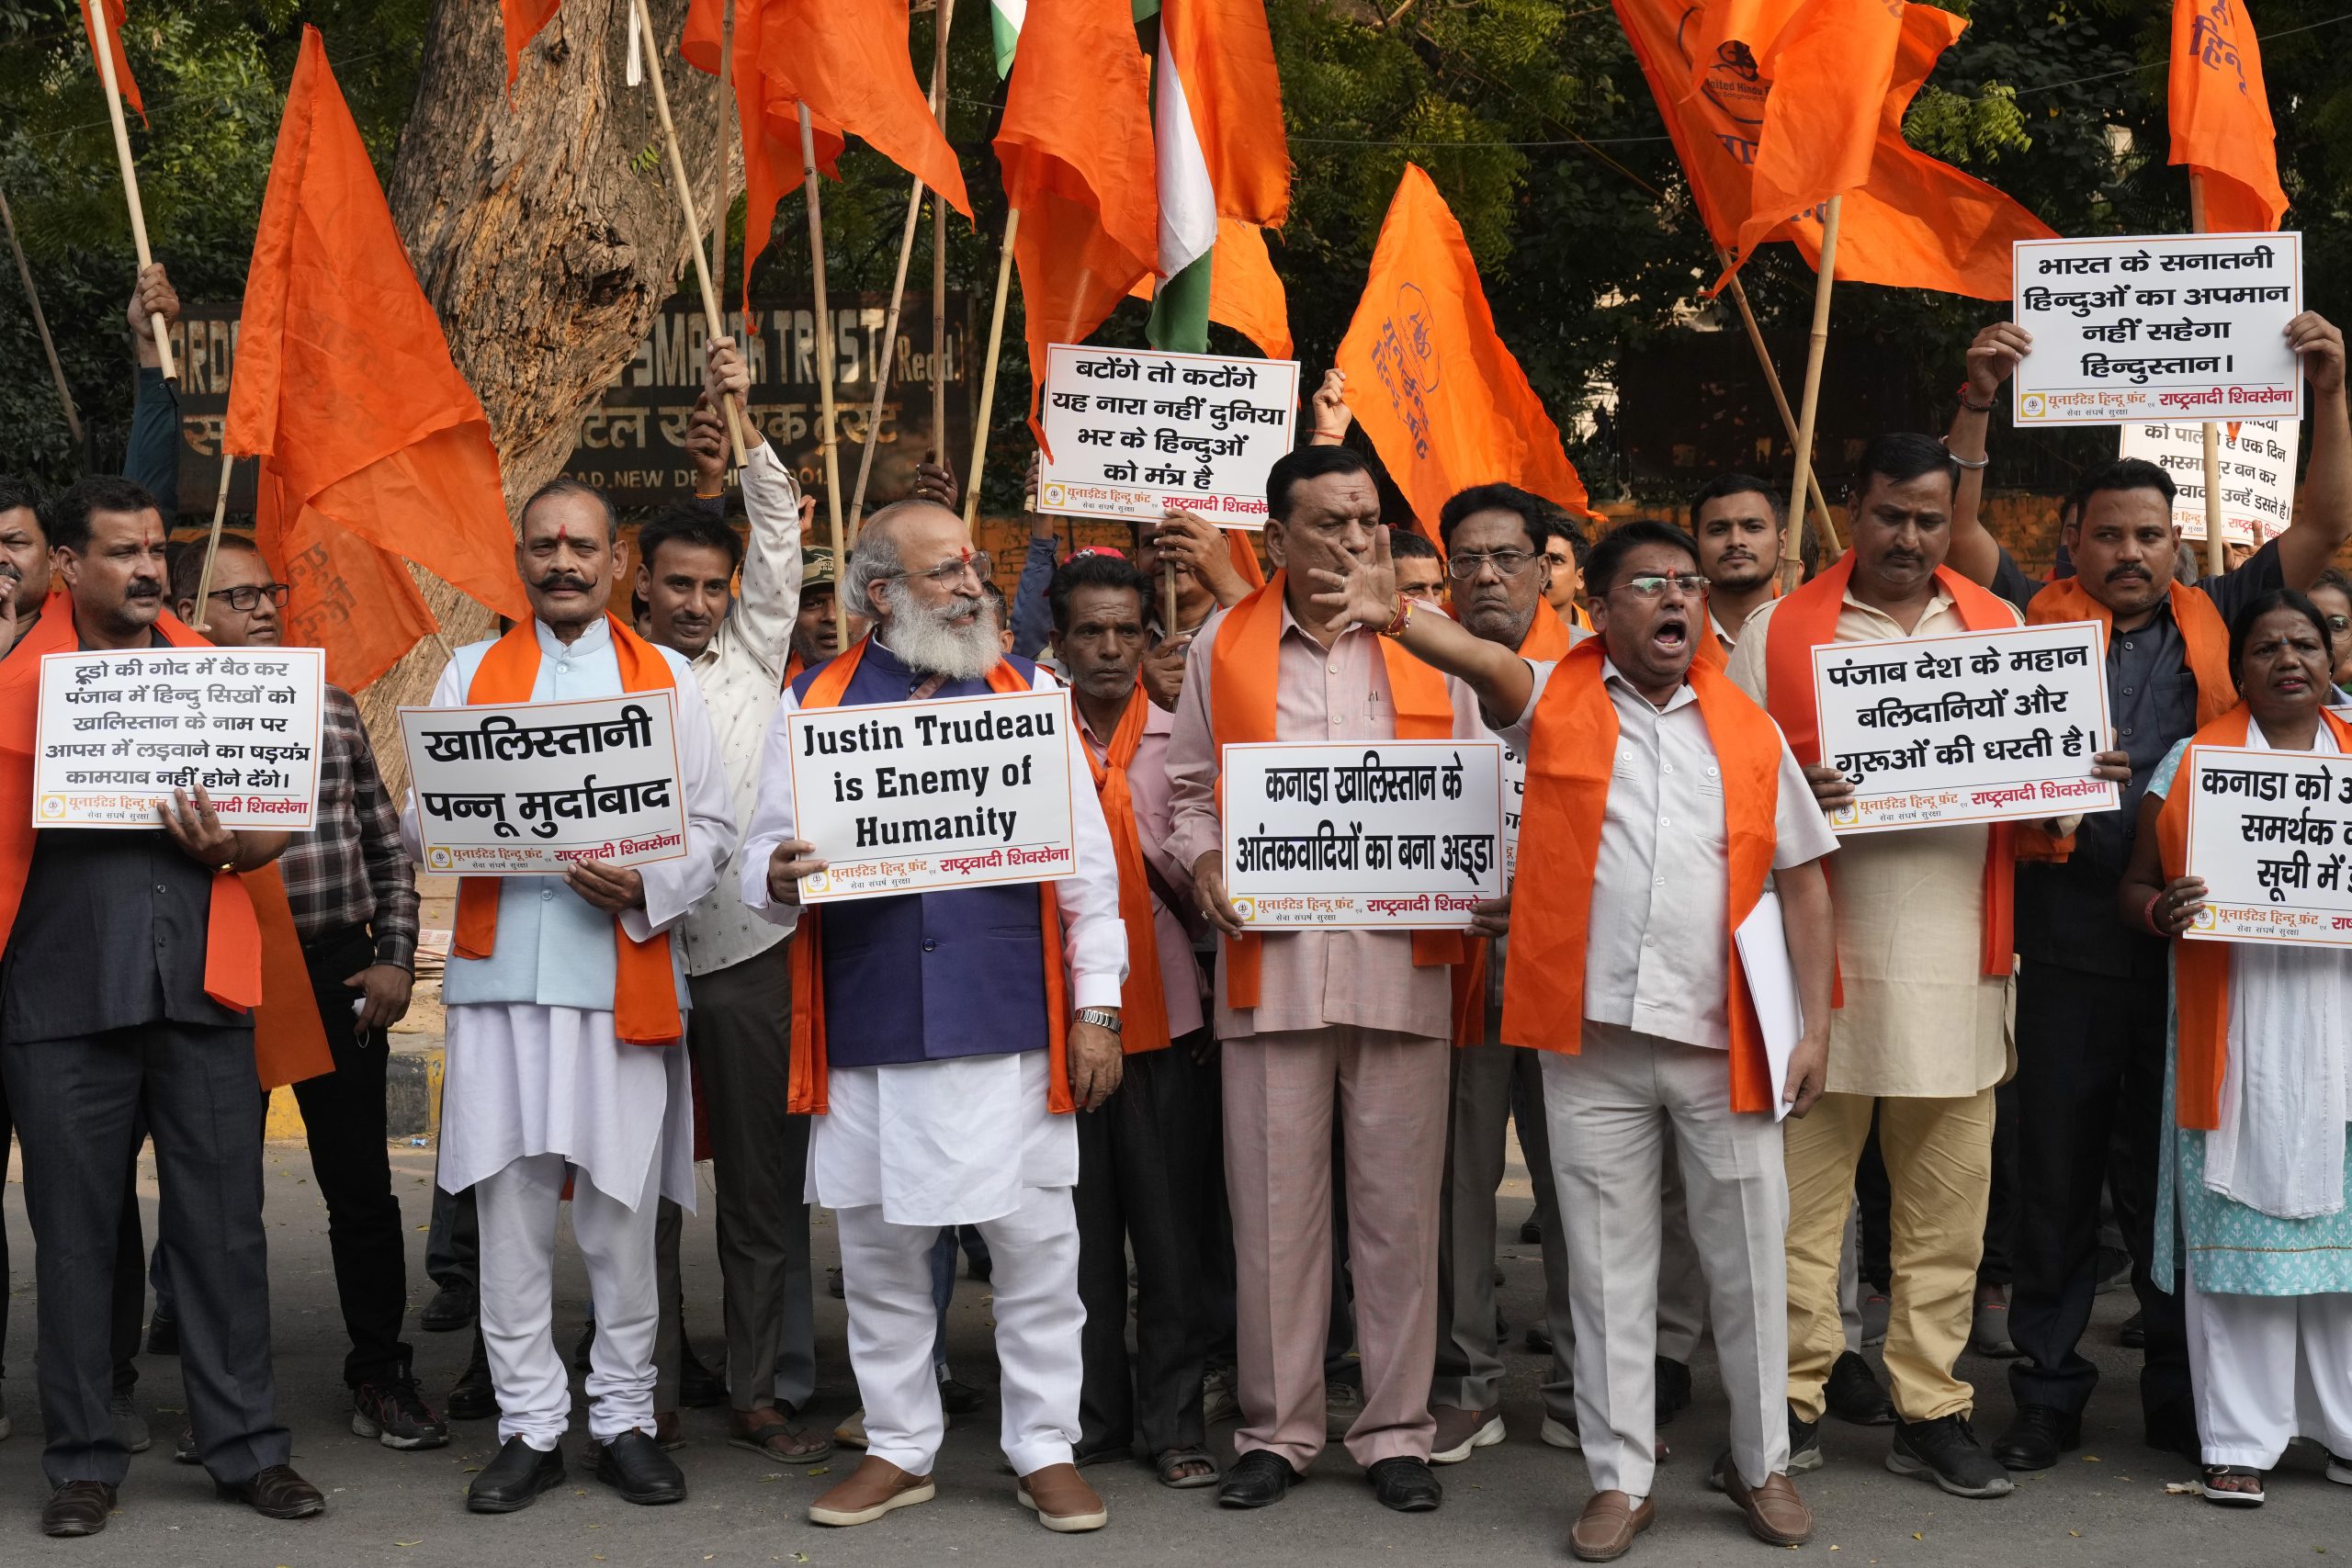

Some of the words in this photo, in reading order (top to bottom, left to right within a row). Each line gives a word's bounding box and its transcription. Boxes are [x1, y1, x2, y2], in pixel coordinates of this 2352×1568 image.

[2039, 256, 2111, 274] भारत
[2120, 249, 2151, 273] के
[2160, 245, 2274, 272] सनातनी
[2024, 285, 2131, 317] हिन्दुओं
[2135, 289, 2177, 306] का
[2184, 286, 2290, 305] अपमान
[2083, 317, 2143, 343] नहीं
[2146, 317, 2232, 341] सहेगा
[1076, 356, 1140, 381] बटोंगे
[1148, 361, 1176, 384] तो
[1182, 366, 1257, 389] कटोंगे
[1052, 392, 1090, 412] यह
[1097, 396, 1148, 415] नारा
[1154, 396, 1206, 420] नहीं
[1210, 400, 1286, 430] दुनिया
[2098, 392, 2125, 407] हिन्दू
[2127, 391, 2146, 404] फ्रंट
[2160, 387, 2223, 410] राष्ट्रवादी
[2228, 387, 2293, 404] शिवसेना
[2109, 409, 2128, 417] सुरक्षा
[1078, 429, 1115, 446] भर
[1120, 426, 1148, 448] के
[1155, 428, 1250, 463] हिन्दुओं
[2241, 437, 2264, 454] एक
[2267, 439, 2286, 462] दिन
[1103, 460, 1138, 482] को
[1145, 463, 1187, 486] मंत्र
[1193, 465, 1214, 490] है
[2234, 463, 2256, 479] बन
[2259, 468, 2277, 486] कर
[1110, 490, 1132, 504] हिन्दू
[1135, 492, 1151, 502] फ्रंट
[2222, 487, 2253, 506] उन्हें
[2255, 495, 2278, 514] डसते
[115, 659, 143, 676] की
[149, 658, 190, 675] गोद
[196, 657, 218, 675] में
[220, 657, 250, 675] बैठ
[254, 662, 288, 677] कर
[1827, 659, 1907, 687] पंजाब
[1915, 651, 1962, 680] देश
[1970, 646, 2001, 676] के
[2008, 646, 2088, 672] महान
[65, 687, 123, 705] पंजाब
[129, 685, 150, 702] में
[153, 683, 201, 709] हिन्दु
[207, 683, 266, 704] सिखों
[268, 685, 296, 705] को
[1857, 689, 2008, 728] बलिदानियों
[2014, 684, 2068, 716] और
[73, 711, 178, 730] खालिस्तान
[185, 712, 207, 729] के
[213, 716, 253, 731] नाम
[261, 718, 288, 732] पर
[421, 705, 652, 762] खालिस्तानी
[804, 720, 903, 756] Justin
[915, 710, 1055, 747] Trudeau
[46, 744, 106, 759] आपस
[112, 739, 133, 756] में
[137, 739, 210, 761] लड़वाने
[216, 745, 243, 760] का
[1935, 735, 1975, 765] की
[1984, 728, 2052, 760] धरती
[2061, 725, 2097, 758] है।
[66, 771, 151, 784] कामयाब
[156, 766, 199, 786] नहीं
[202, 769, 241, 788] होने
[246, 769, 288, 788] देंगे।
[834, 772, 863, 802] is
[876, 766, 989, 798] Enemy
[1002, 755, 1031, 786] of
[1265, 767, 1329, 806] कनाडा
[1334, 750, 1437, 804] खालिस्तान
[1442, 751, 1463, 800] के
[2201, 768, 2289, 801] कनाडा
[2295, 764, 2333, 802] को
[121, 795, 146, 811] हिन्दू
[247, 797, 308, 814] शिवसेना
[422, 792, 520, 839] पन्नू
[515, 774, 672, 839] मुर्दाबाद
[1910, 795, 1937, 809] हिन्दू
[1939, 792, 1958, 804] फ्रंट
[1971, 784, 2036, 808] राष्ट्रवादी
[2041, 779, 2107, 800] शिवसेना
[855, 807, 1017, 847] Humanity
[1922, 810, 1940, 819] सुरक्षा
[2241, 807, 2336, 845] समर्थक
[498, 848, 522, 861] हिन्दू
[525, 847, 543, 859] फ्रंट
[620, 834, 681, 855] शिवसेना
[880, 863, 907, 875] हिन्दू
[909, 859, 927, 872] फ्रंट
[940, 850, 1003, 875] राष्ट्रवादी
[1007, 847, 1069, 866] शिवसेना
[1236, 819, 1363, 873] आंतकवादियों
[1365, 835, 1393, 870] का
[1397, 835, 1435, 870] बना
[1441, 835, 1494, 886] अड्डा
[2257, 850, 2311, 901] सूची
[2317, 852, 2346, 890] में
[1307, 897, 1333, 912] हिन्दू
[1334, 897, 1354, 909] फ्रंट
[1367, 895, 1430, 917] राष्ट्रवादी
[2270, 910, 2297, 927] हिन्दू
[2299, 912, 2319, 925] फ्रंट
[2279, 928, 2299, 937] सुरक्षा
